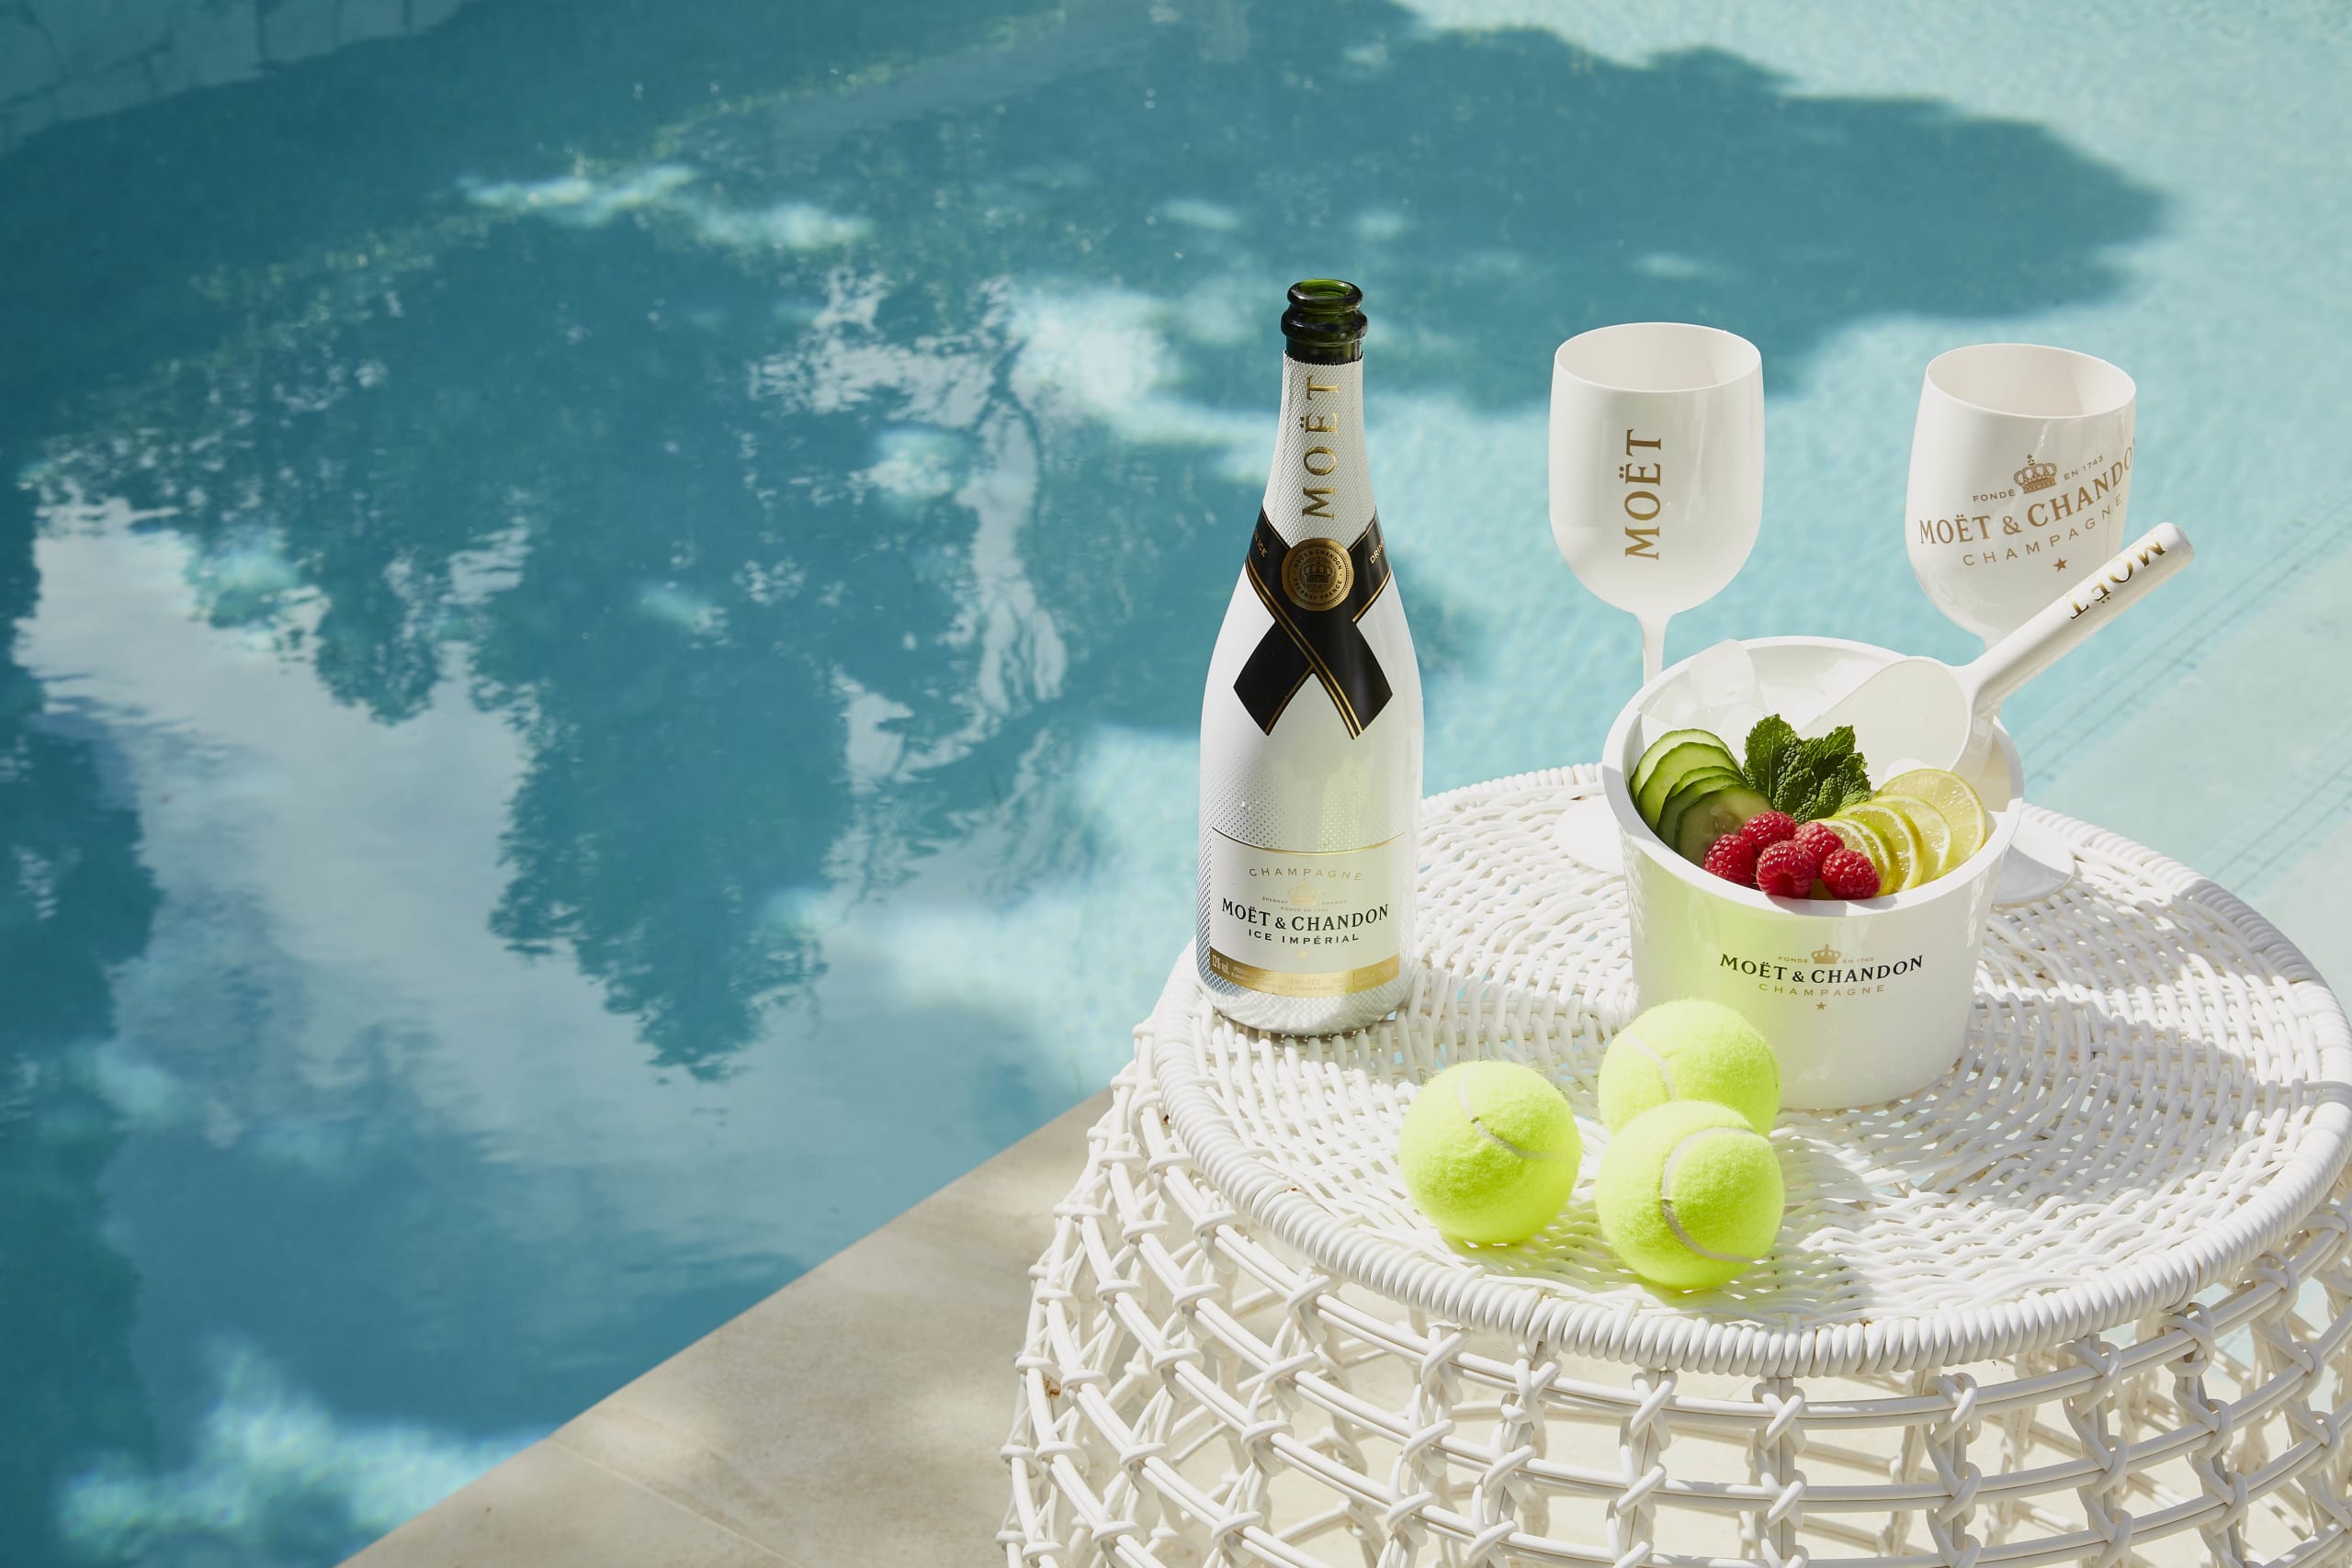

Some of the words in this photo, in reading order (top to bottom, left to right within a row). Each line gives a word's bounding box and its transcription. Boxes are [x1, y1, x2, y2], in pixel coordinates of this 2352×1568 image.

[1300, 375, 1340, 521] MOËT
[2064, 469, 2078, 480] EN
[2082, 455, 2104, 471] 1743
[1619, 429, 1661, 560] MOËT
[1919, 514, 1991, 544] MOËT
[2002, 515, 2022, 536] &
[2027, 439, 2134, 527] CHANDO
[1962, 493, 2123, 566] CHAMPAGNE
[1250, 868, 1363, 881] CHAMPAGNE
[1222, 897, 1271, 927] MOËT
[1274, 917, 1286, 930] &
[1291, 904, 1388, 931] CHANDON
[1249, 929, 1272, 942] ICE
[1282, 934, 1359, 945] IMPÉRIAL
[1719, 953, 1788, 980] MOËT
[1792, 971, 1805, 983] &
[1811, 954, 1924, 984] CHANDON
[1758, 983, 1885, 997] CHAMPAGNE
